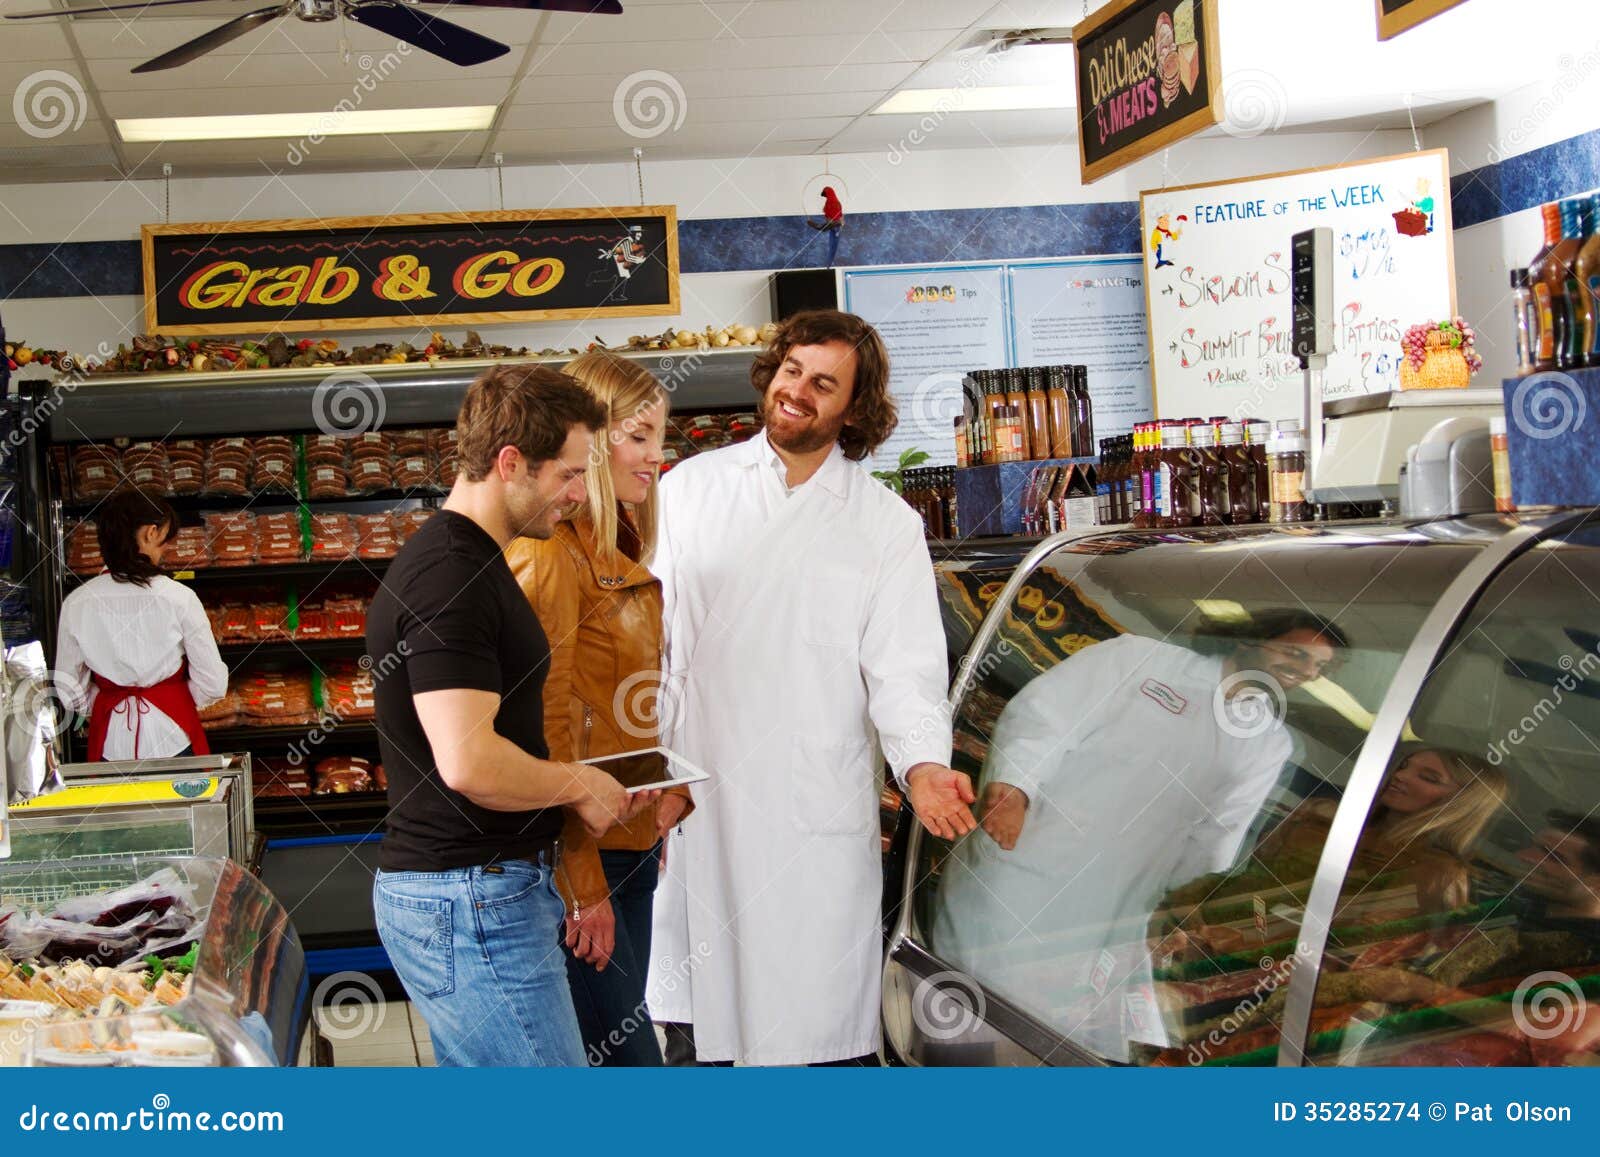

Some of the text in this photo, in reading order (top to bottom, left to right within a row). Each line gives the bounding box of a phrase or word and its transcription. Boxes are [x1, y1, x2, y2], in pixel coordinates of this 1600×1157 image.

[1109, 76, 1159, 135] MEATS
[1195, 184, 1385, 225] FEATURE OF THE WEEK
[179, 250, 565, 310] Grab & Go
[960, 287, 978, 299] Tips
[1125, 277, 1142, 289] Tips
